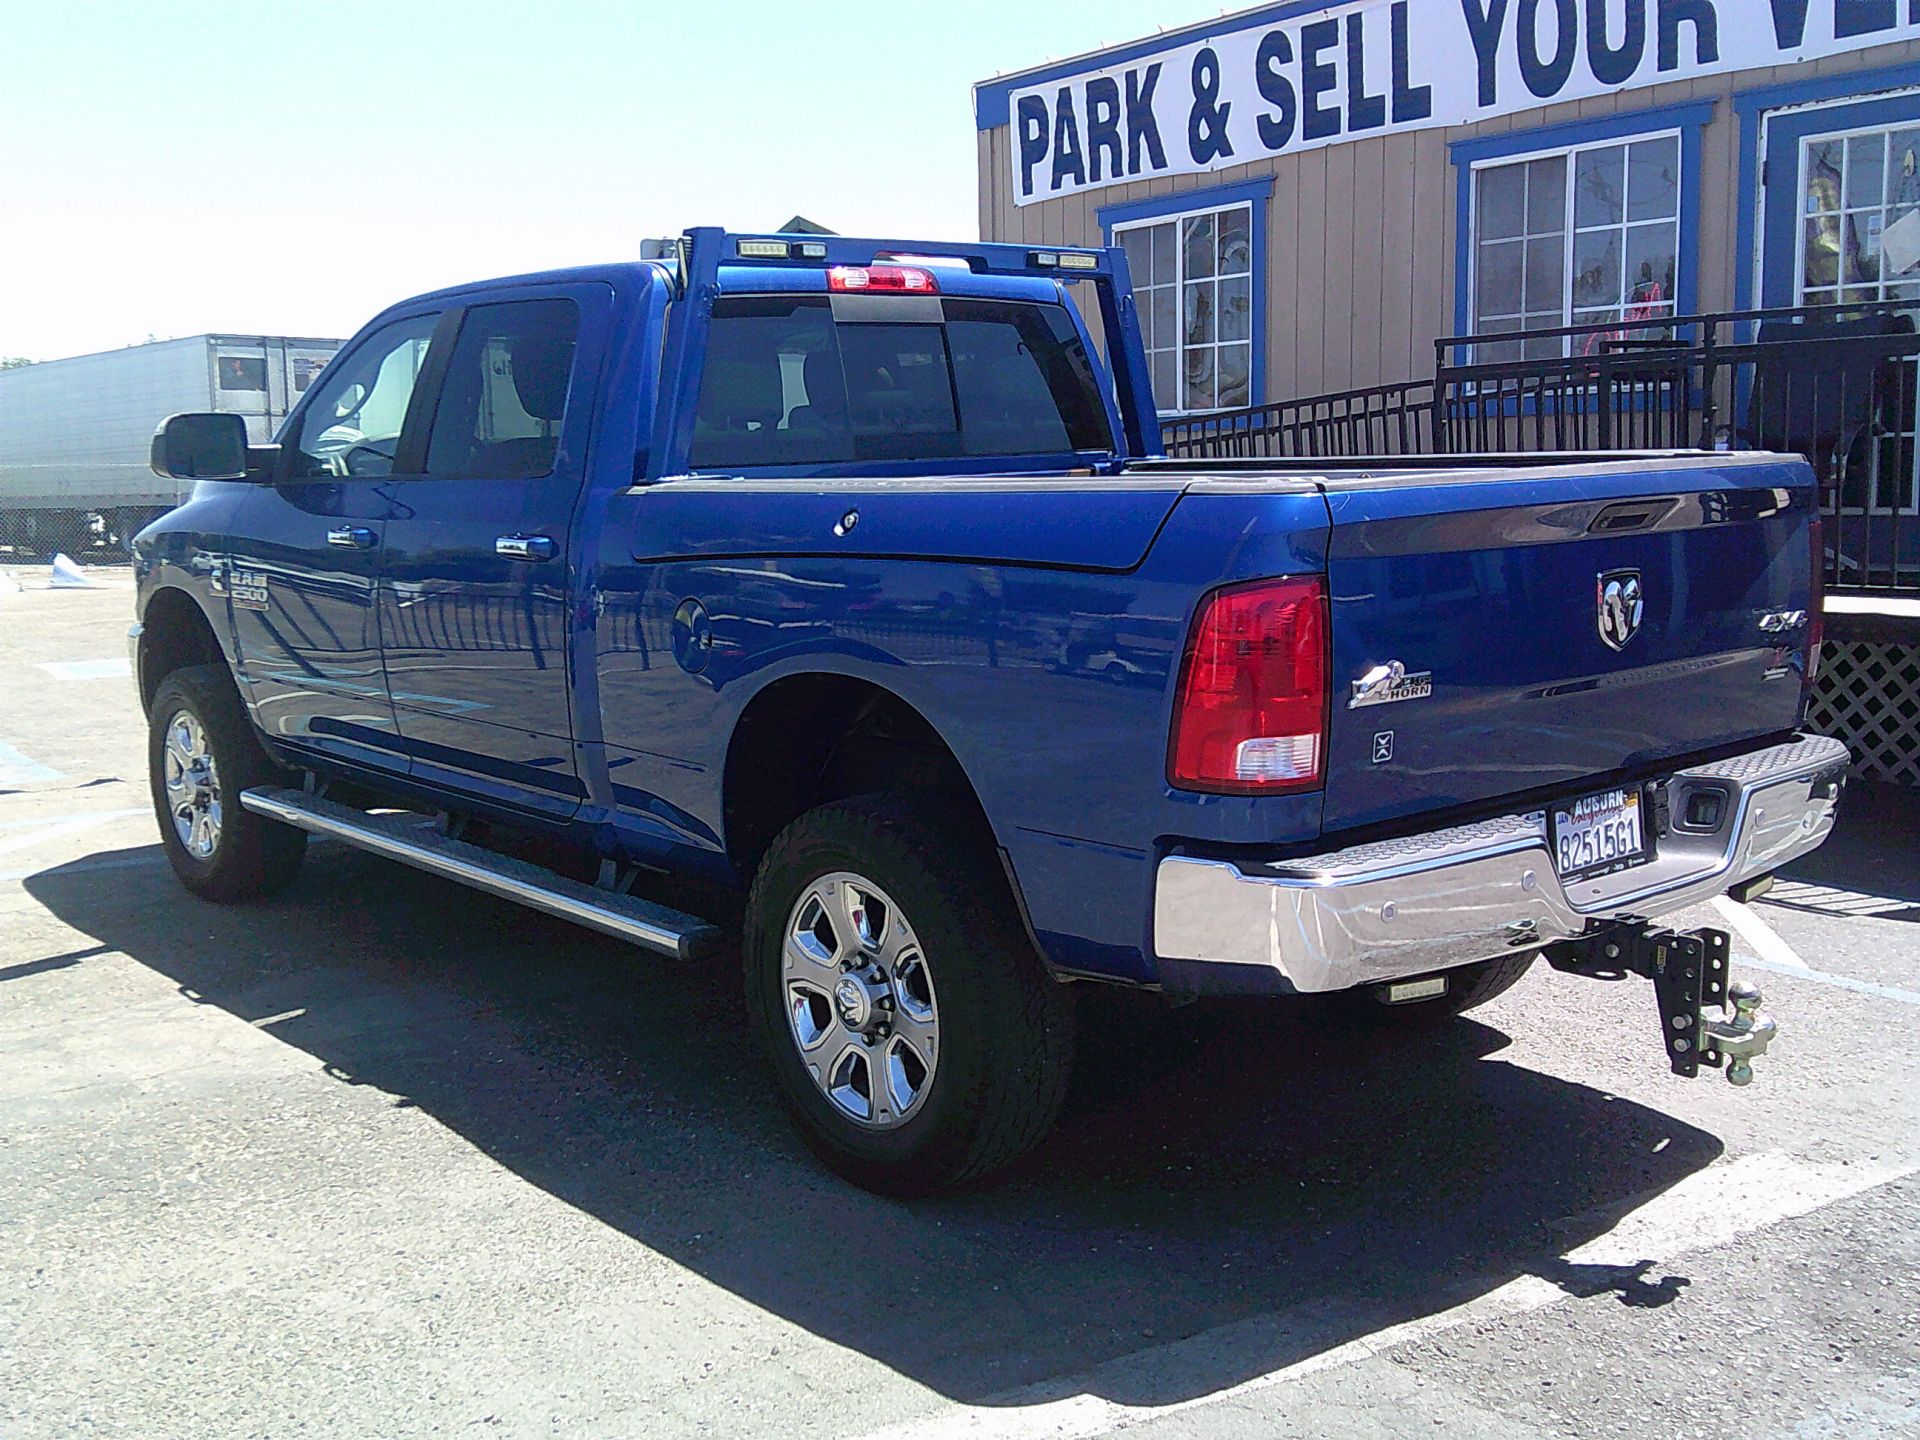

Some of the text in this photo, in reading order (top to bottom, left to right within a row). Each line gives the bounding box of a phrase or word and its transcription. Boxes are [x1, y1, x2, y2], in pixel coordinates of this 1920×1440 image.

[1017, 62, 1169, 196] PARK
[1188, 47, 1235, 164] &
[1255, 0, 1432, 150] SELL
[1390, 685, 1429, 699] HORN
[1574, 789, 1624, 817] AUBURN
[1560, 817, 1639, 872] 82515G1
